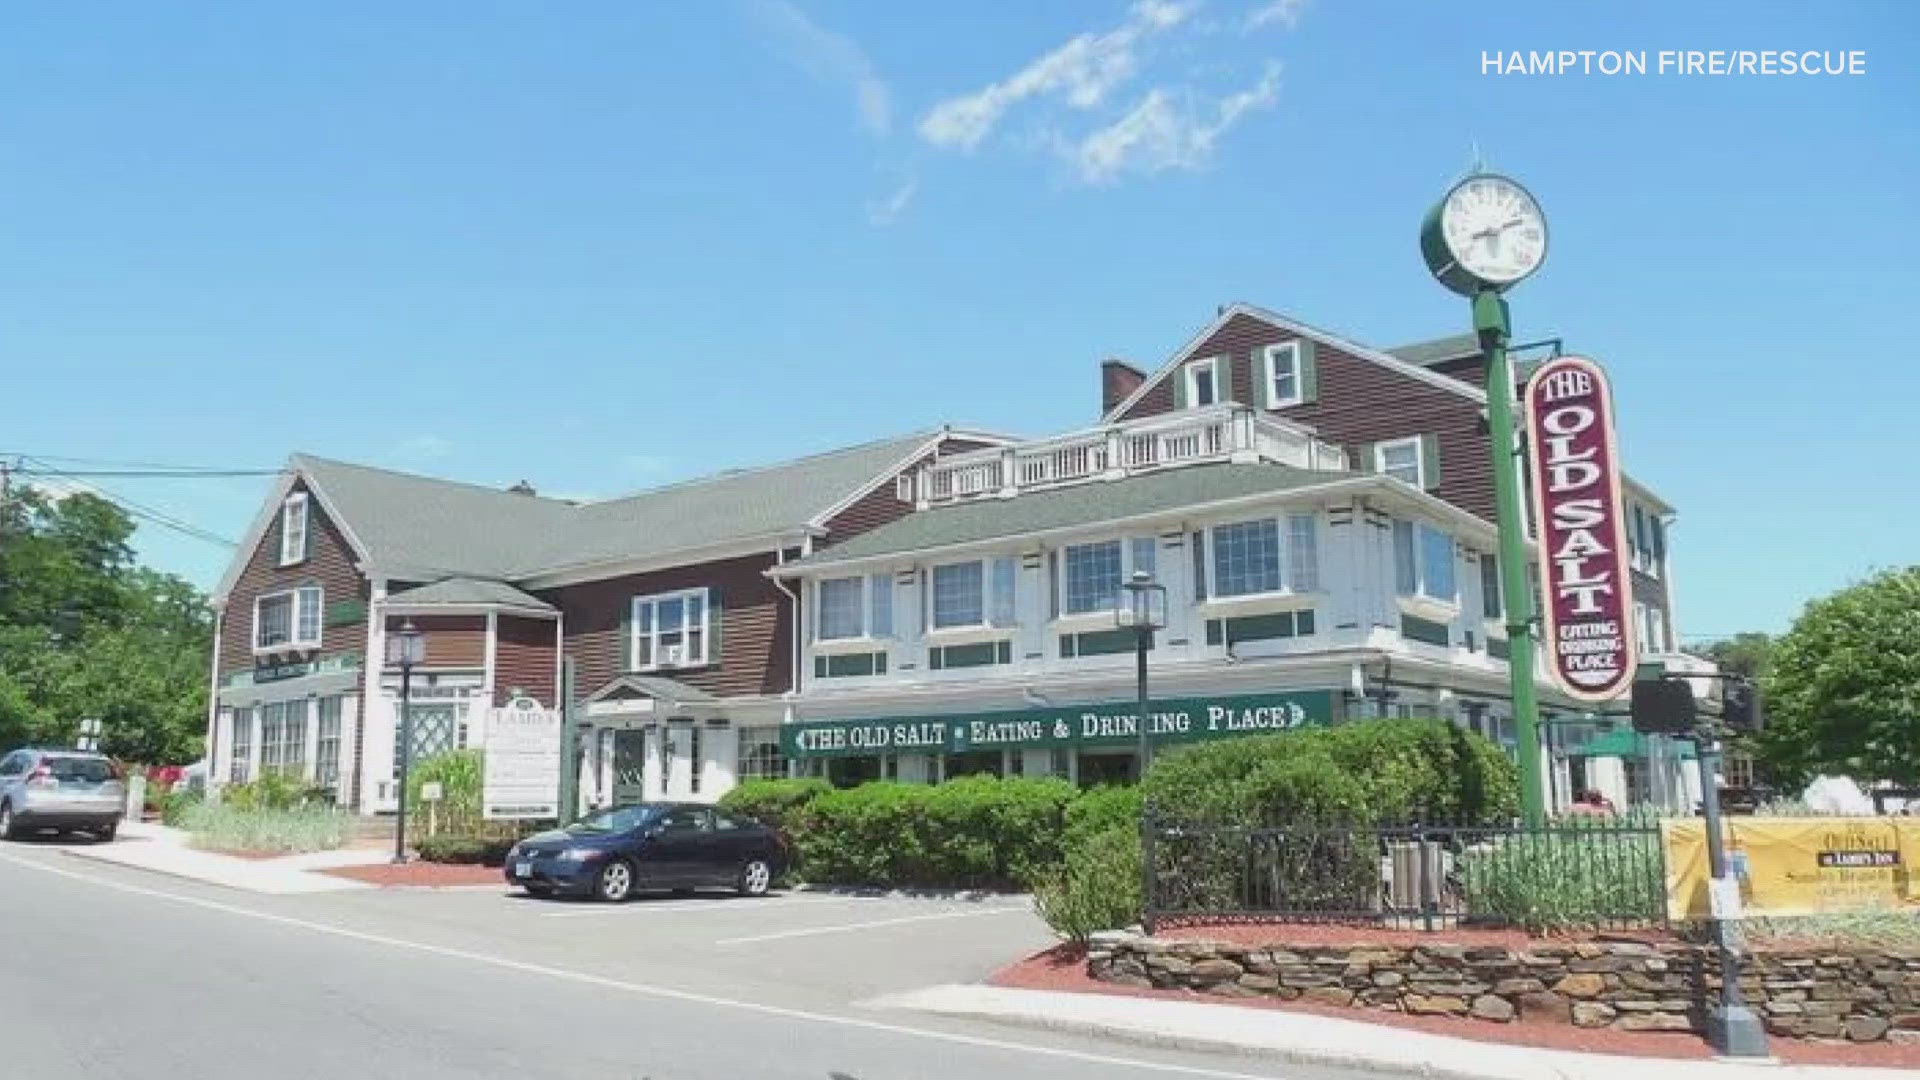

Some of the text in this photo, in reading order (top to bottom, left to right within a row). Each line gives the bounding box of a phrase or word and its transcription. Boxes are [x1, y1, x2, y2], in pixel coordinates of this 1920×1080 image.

[1540, 370, 1592, 402] THE
[1543, 405, 1601, 492] OLD
[1552, 498, 1613, 615] SALT
[1566, 653, 1618, 671] PLACE
[802, 705, 1285, 750] THE OLD SALT EATING & DRINING PLACE
